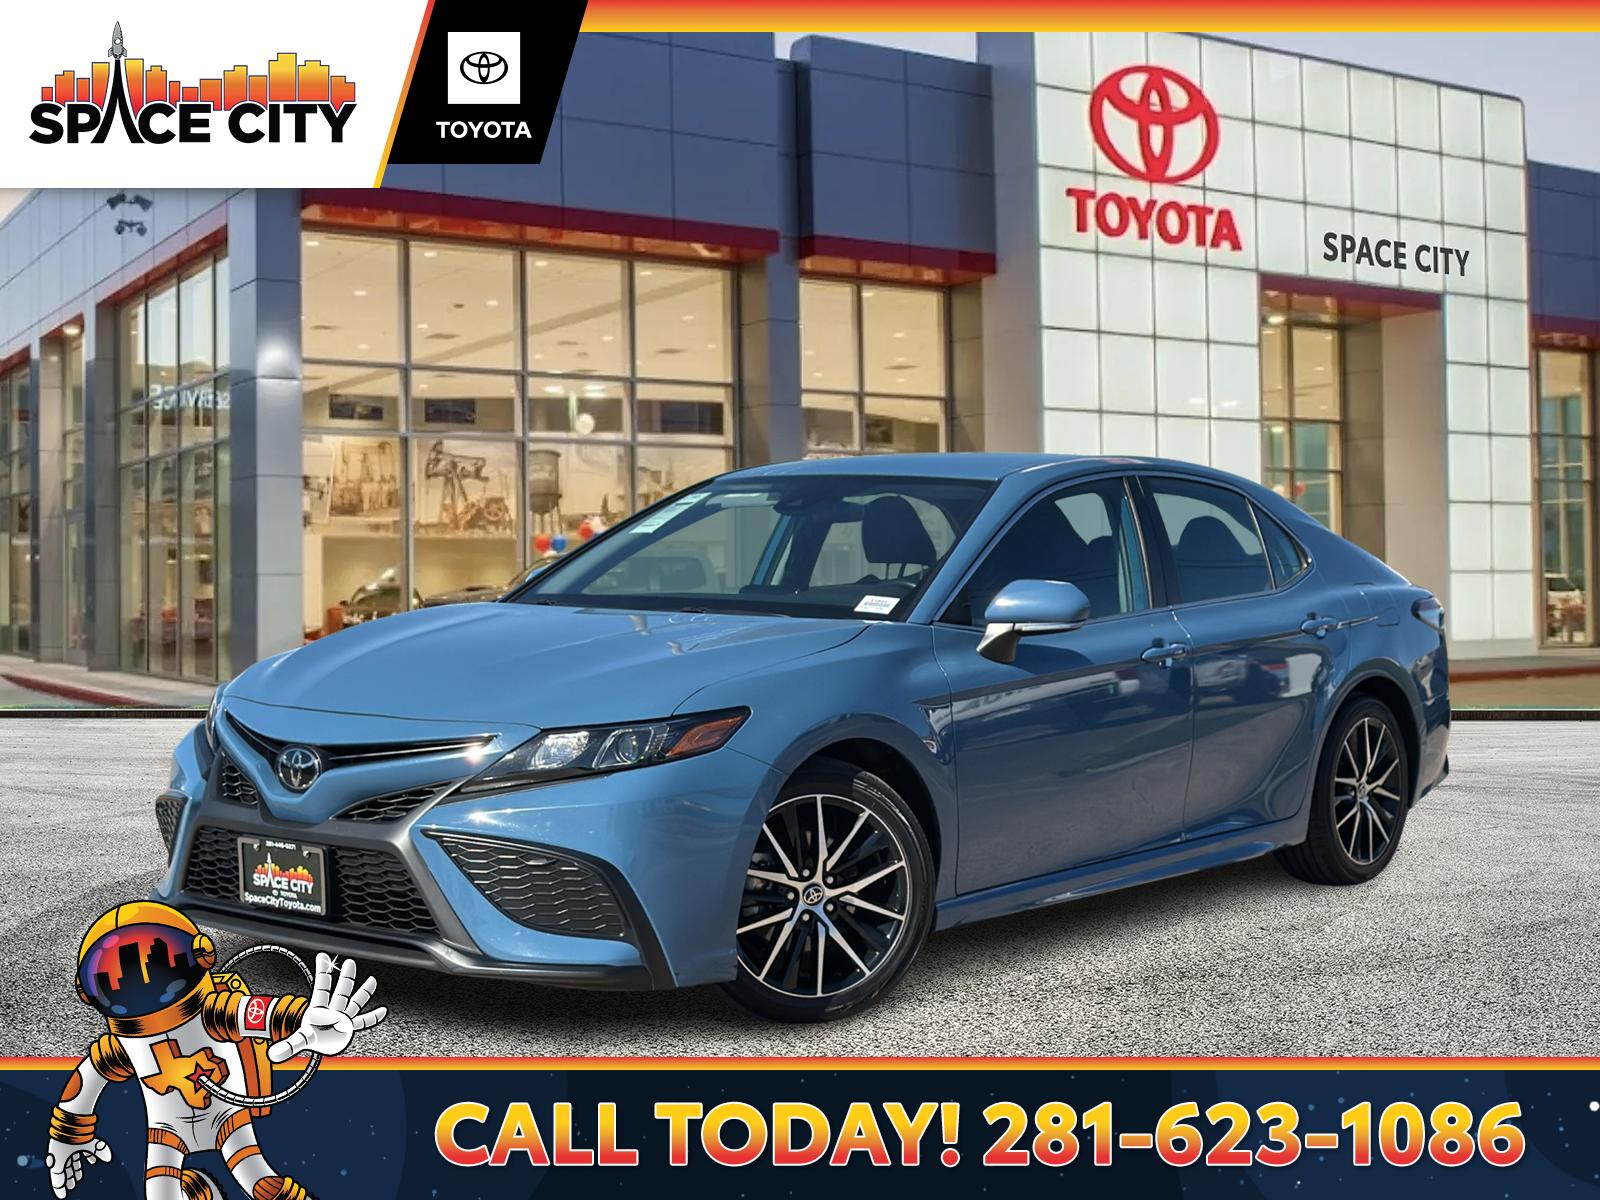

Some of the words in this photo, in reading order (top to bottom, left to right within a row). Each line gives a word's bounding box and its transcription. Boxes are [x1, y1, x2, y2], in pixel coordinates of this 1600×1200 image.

[1066, 188, 1243, 251] TOYOTA
[1323, 231, 1407, 270] SPACE
[1414, 244, 1471, 277] CITY
[253, 863, 289, 889] SPACE
[290, 879, 314, 894] CITY
[244, 891, 322, 913] SpaceCityToyota.com
[280, 891, 298, 899] TOYOTA
